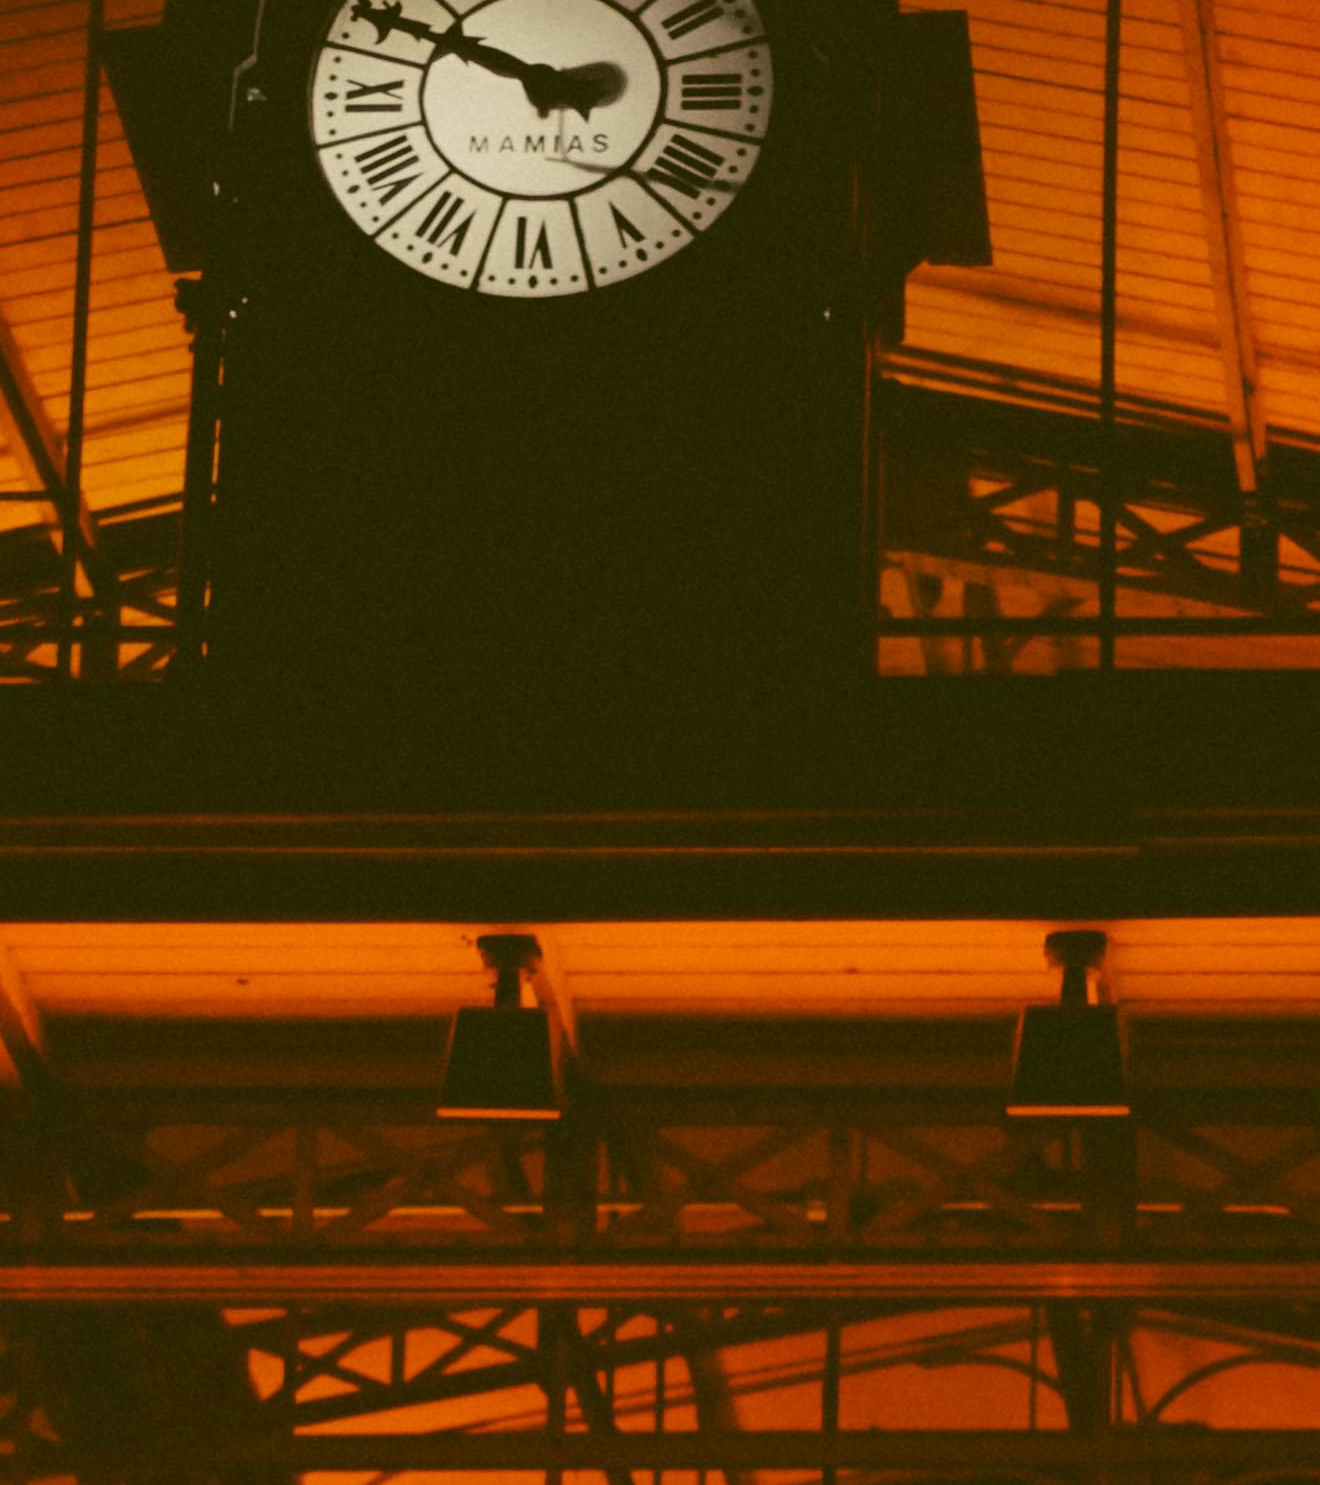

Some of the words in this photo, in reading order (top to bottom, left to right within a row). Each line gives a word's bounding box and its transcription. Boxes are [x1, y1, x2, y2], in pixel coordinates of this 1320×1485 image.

[345, 79, 403, 112] IX
[682, 74, 742, 109] III
[469, 134, 609, 153] MAMIAS
[416, 191, 475, 255] VII
[515, 217, 552, 268] VI
